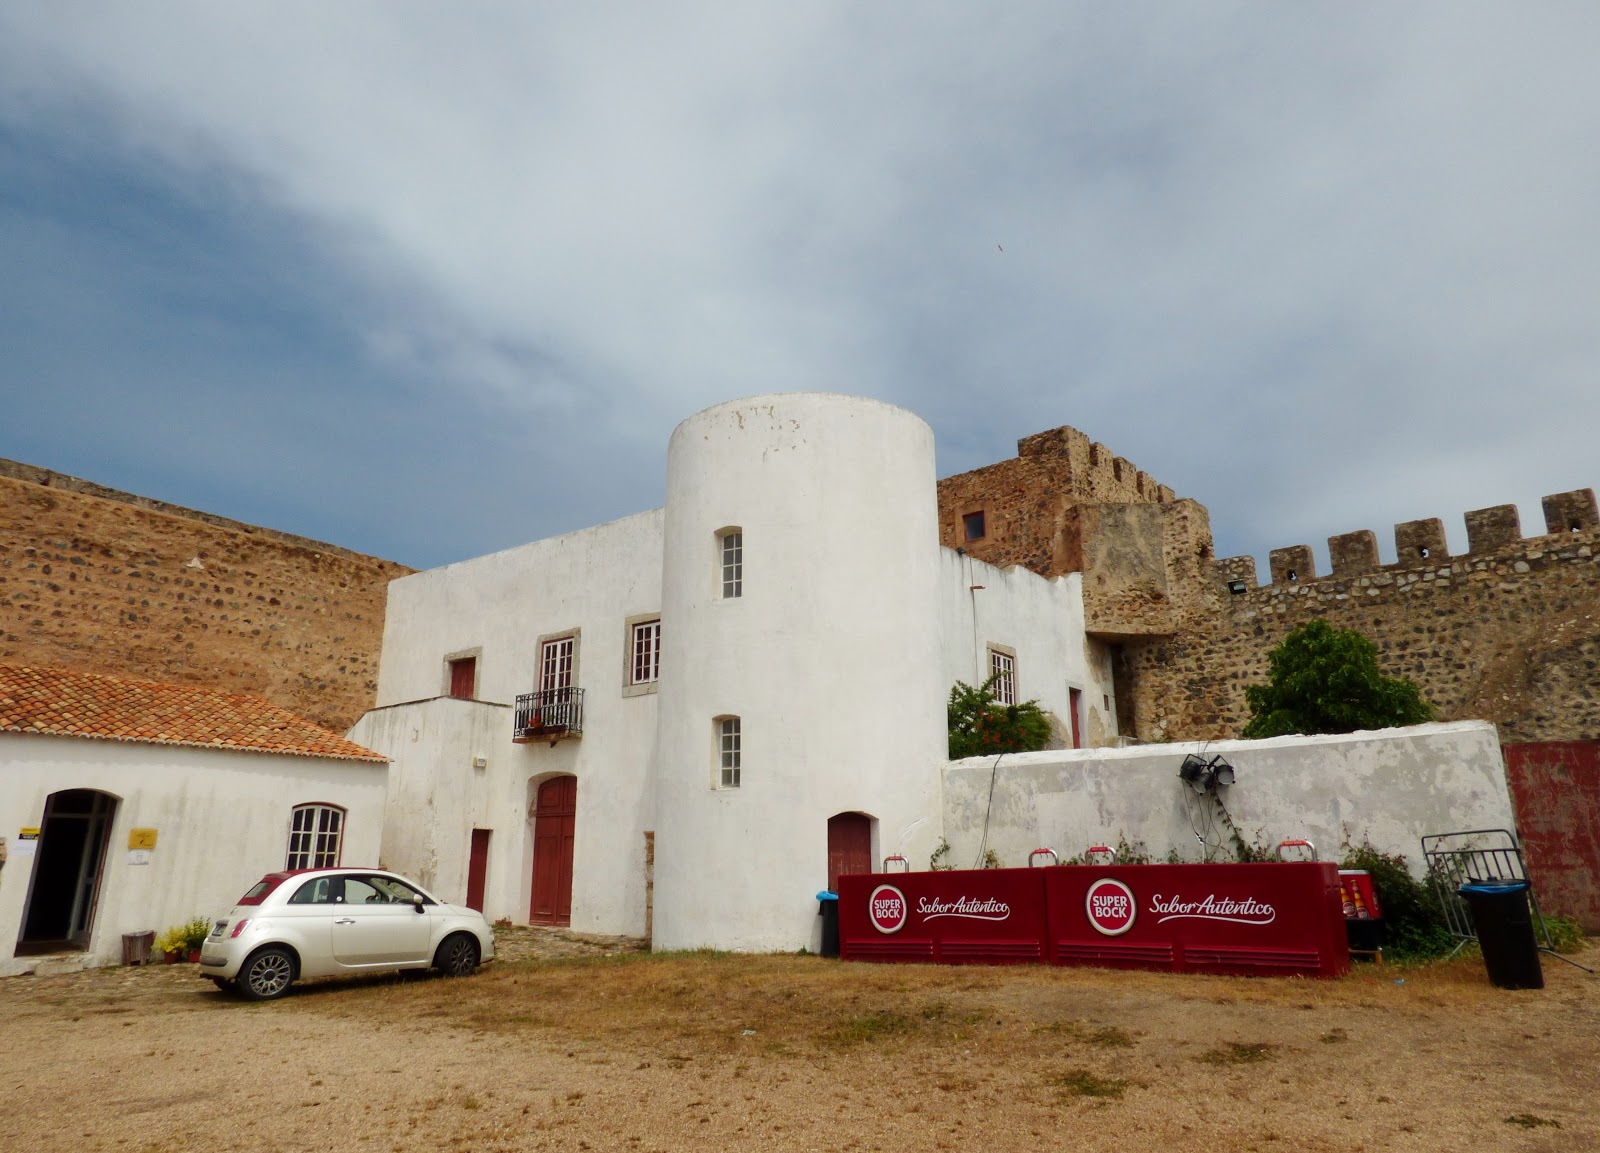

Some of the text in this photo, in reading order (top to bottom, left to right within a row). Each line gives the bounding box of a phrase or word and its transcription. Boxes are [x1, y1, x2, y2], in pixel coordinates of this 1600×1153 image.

[874, 899, 900, 909] SUPER
[917, 896, 951, 913] Sabor
[1093, 895, 1128, 907] SUPER
[1149, 893, 1274, 915] Sabor Autêntico
[876, 909, 900, 918] BOCK
[1095, 907, 1127, 918] BOCK
